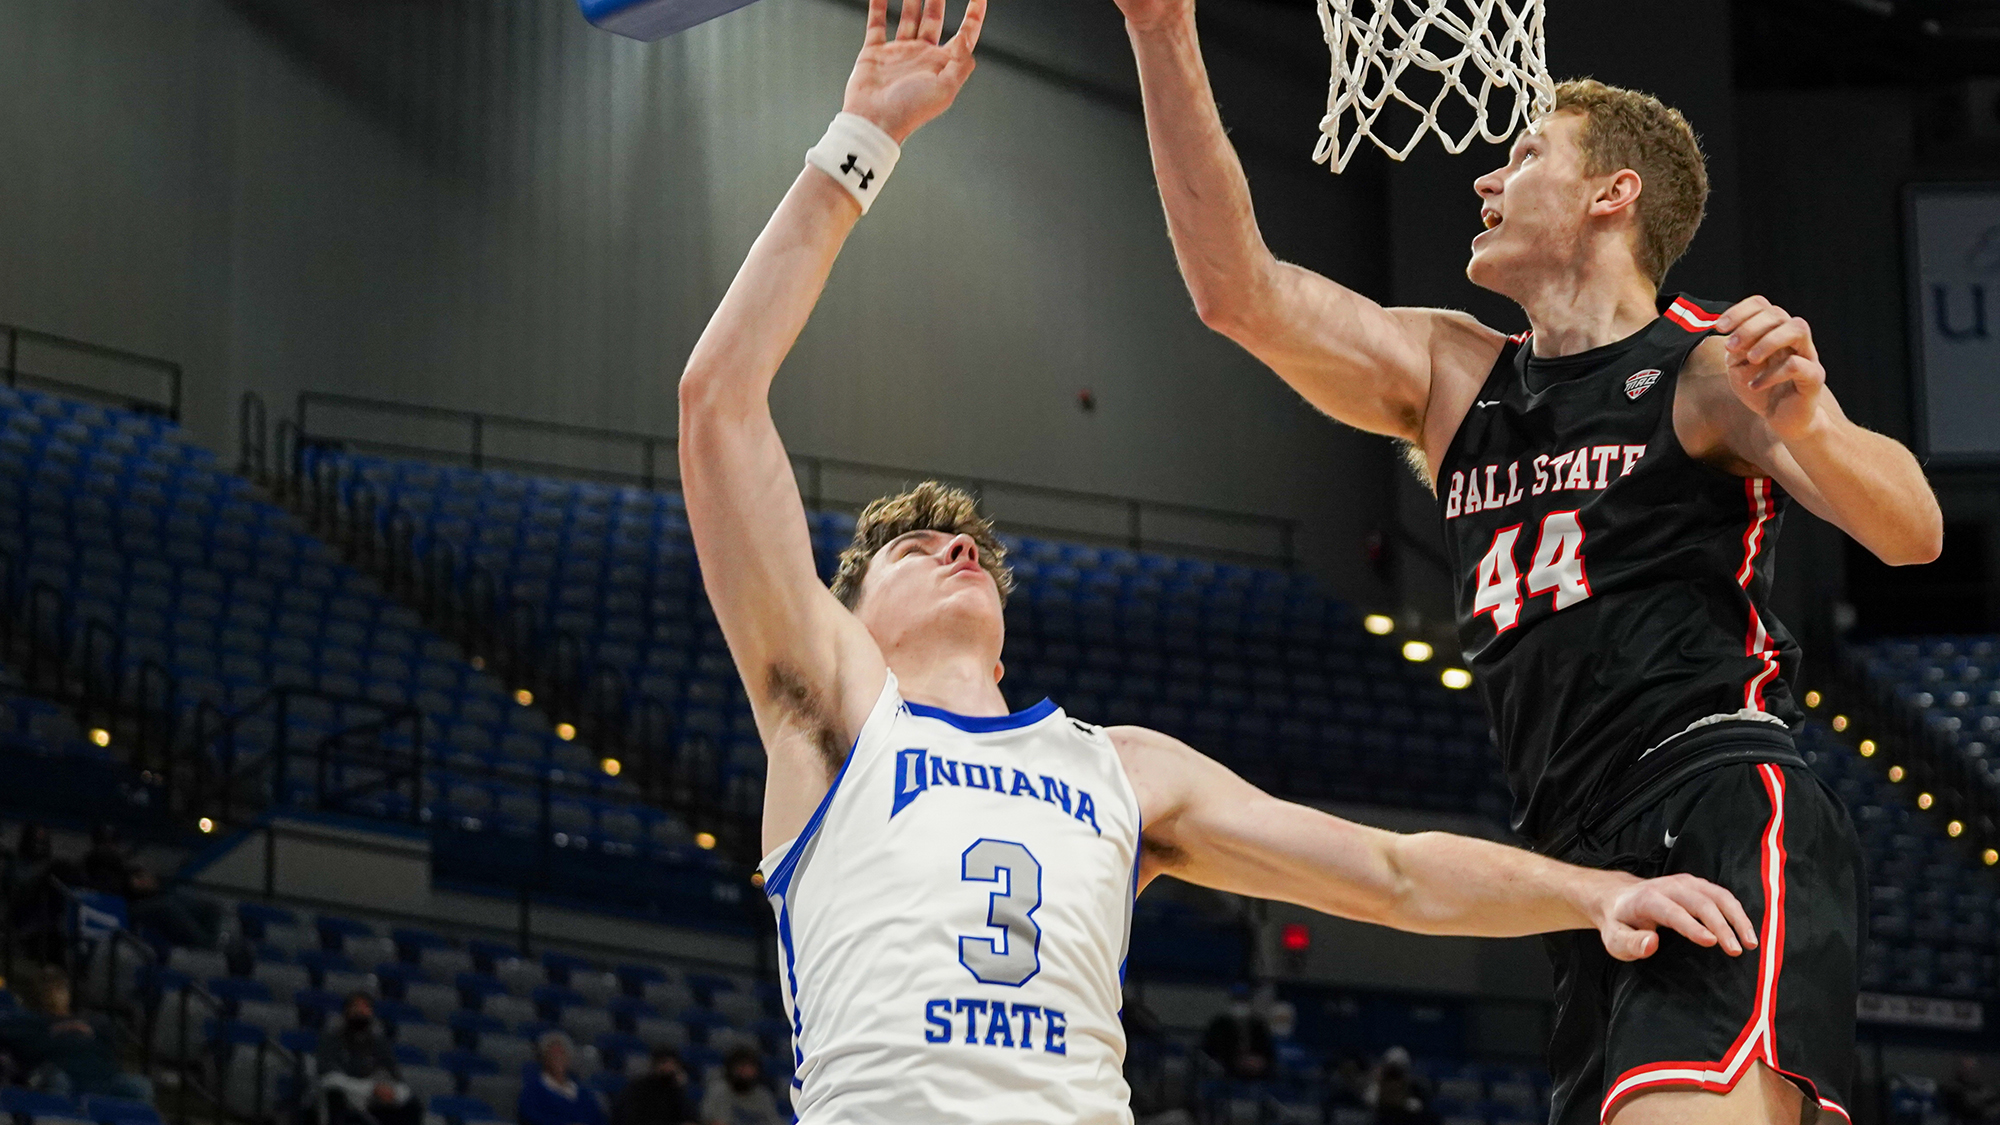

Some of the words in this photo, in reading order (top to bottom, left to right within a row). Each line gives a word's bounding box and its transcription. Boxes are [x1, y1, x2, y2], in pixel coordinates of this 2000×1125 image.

[1624, 374, 1658, 392] MAC
[1446, 460, 1525, 519] BALL
[1531, 444, 1647, 496] STATE
[1473, 508, 1593, 635] 44
[888, 748, 1102, 837] INDIANA
[958, 837, 1042, 987] 3
[925, 998, 1067, 1056] STATE
